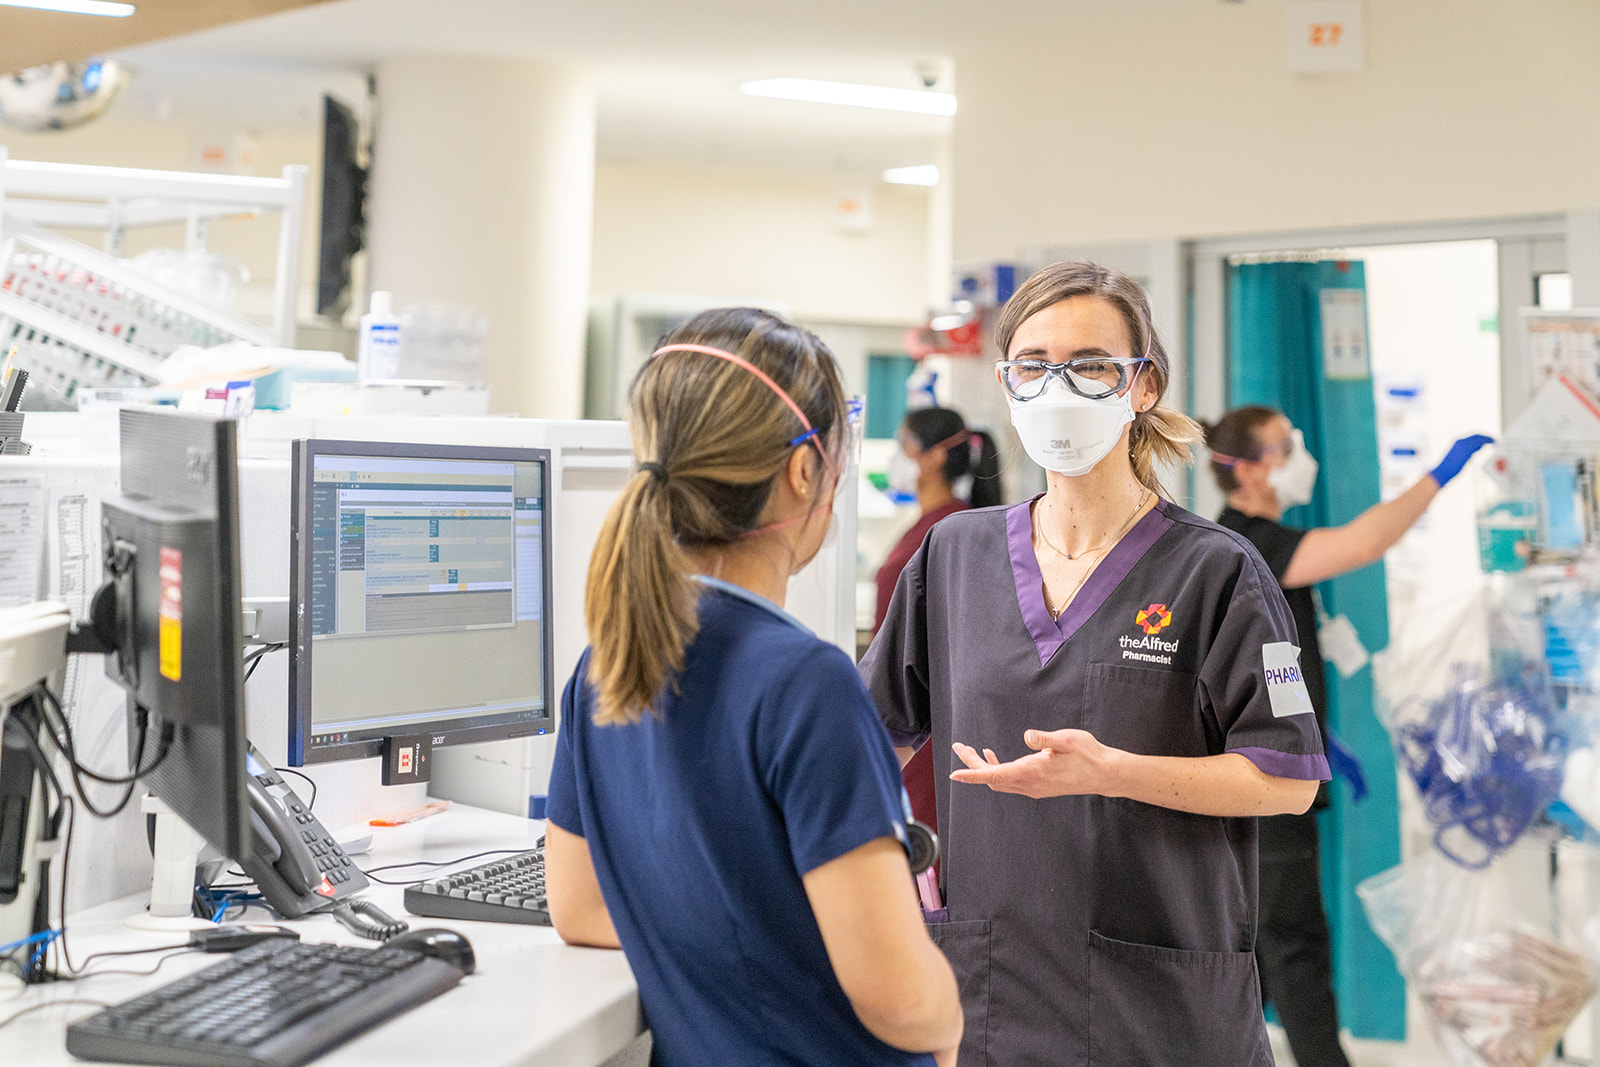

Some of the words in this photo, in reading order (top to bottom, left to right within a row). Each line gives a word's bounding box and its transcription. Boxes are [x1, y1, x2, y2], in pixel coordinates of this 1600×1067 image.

[1050, 439, 1071, 449] 3M
[1119, 635, 1179, 653] theAlfred
[1122, 650, 1172, 665] Pharmacist
[432, 736, 445, 745] acer
